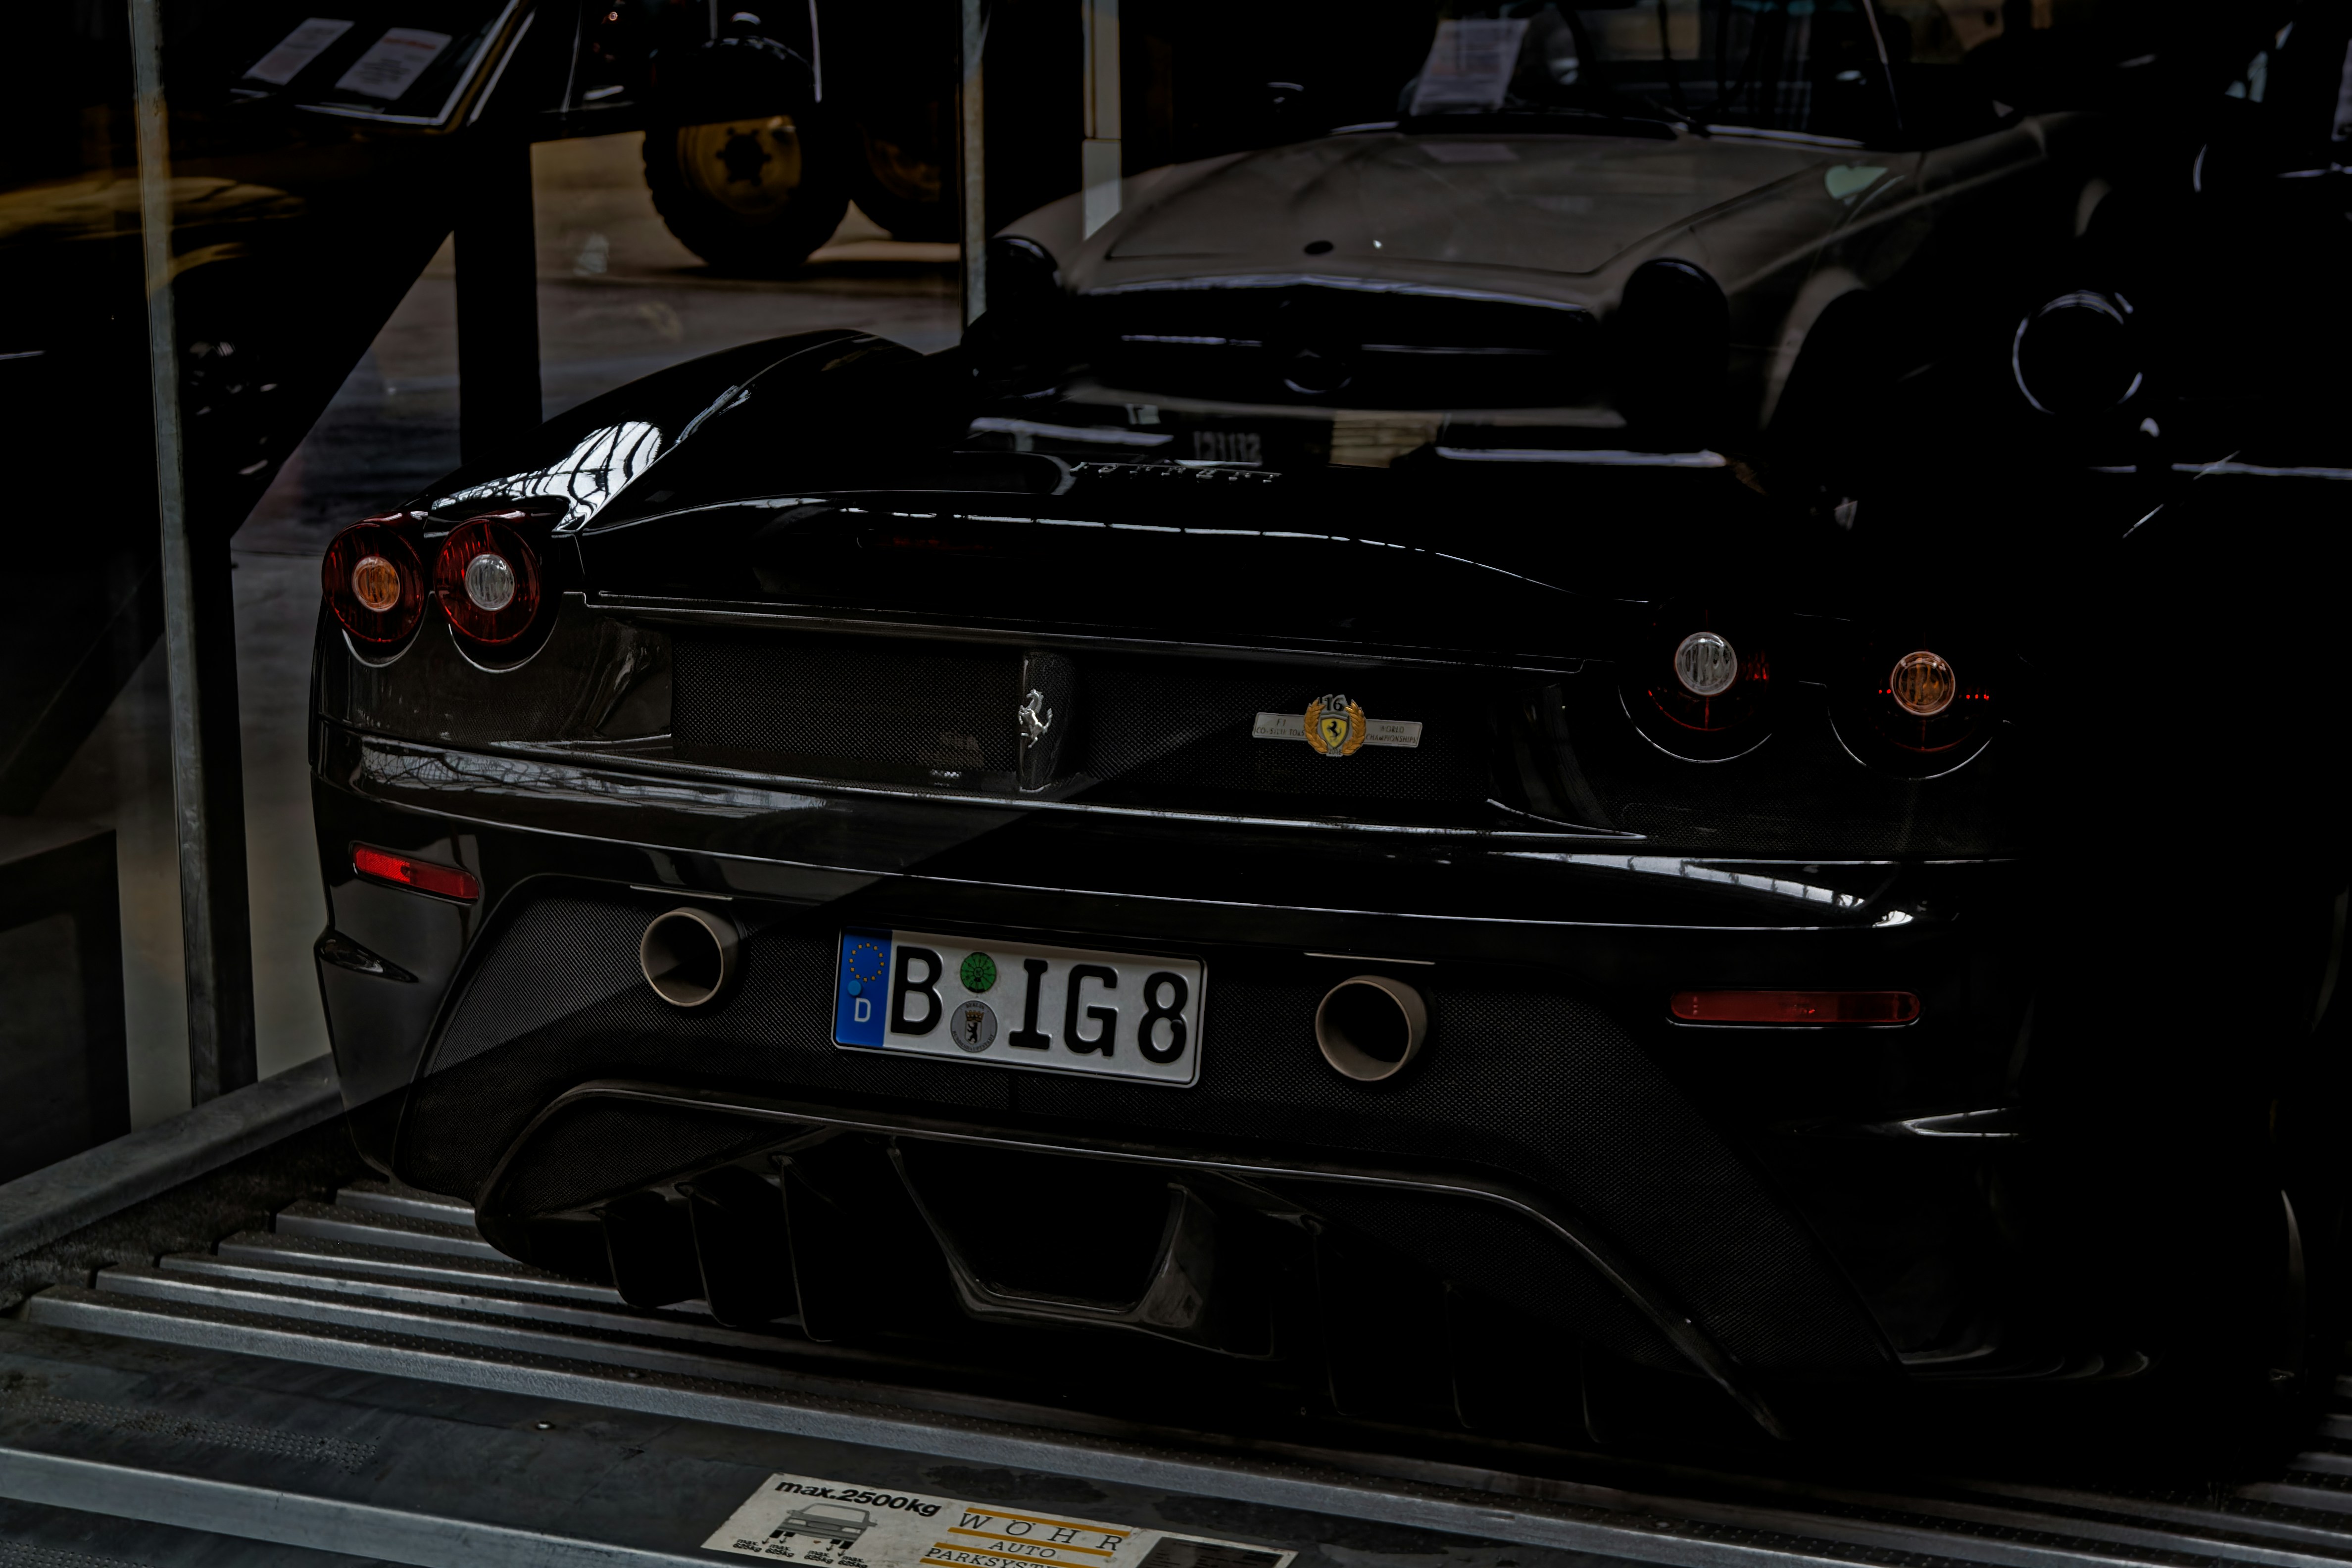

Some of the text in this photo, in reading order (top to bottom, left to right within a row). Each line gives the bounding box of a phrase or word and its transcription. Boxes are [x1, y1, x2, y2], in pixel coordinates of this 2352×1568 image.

[1323, 697, 1343, 711] 16
[1256, 727, 1305, 736] COSTRUTORS
[1276, 718, 1286, 727] F1
[1366, 734, 1416, 743] CHAMPIONSHIPS
[854, 997, 872, 1023] D
[891, 945, 943, 1035] B
[1009, 958, 1187, 1064] IG8
[775, 1481, 942, 1518] max.2500kg
[959, 1513, 1123, 1551] WÖHR
[924, 1547, 1060, 1568] PARKSYST
[988, 1541, 1056, 1558] AUTO
